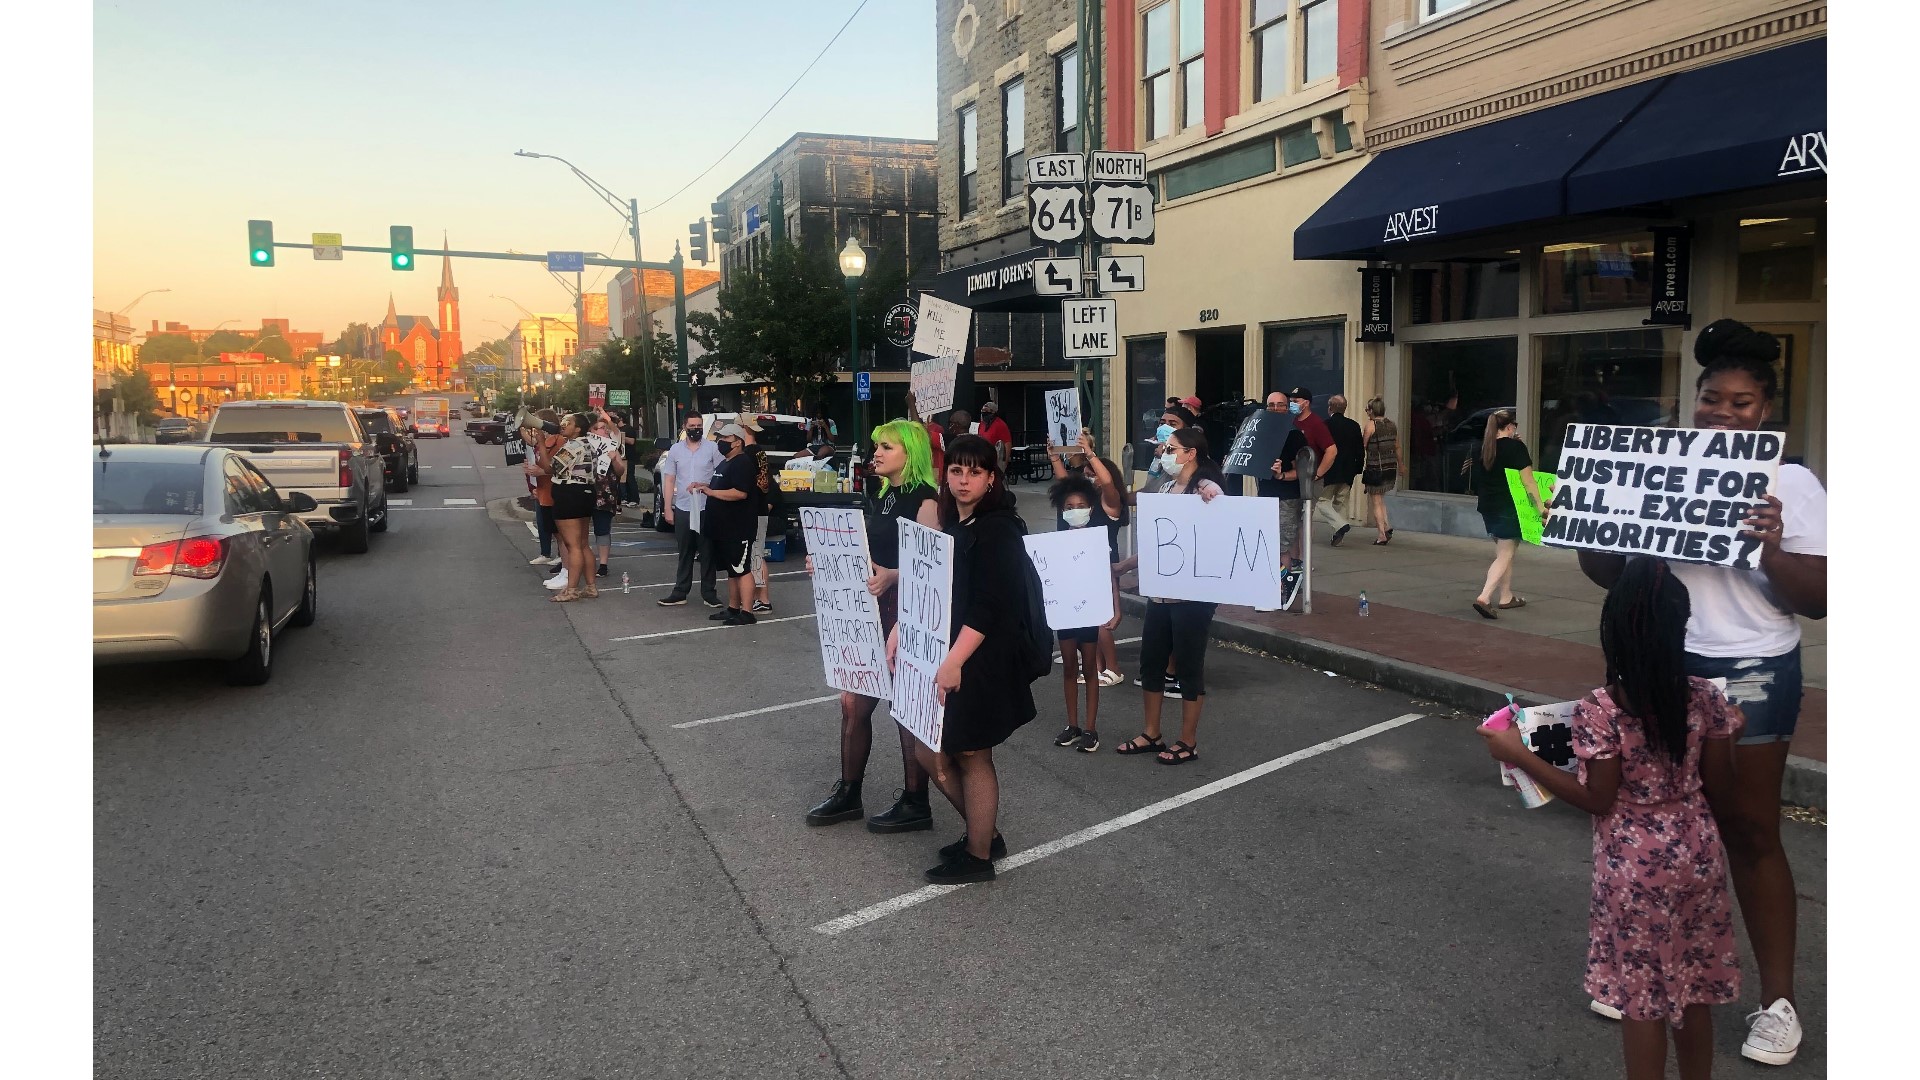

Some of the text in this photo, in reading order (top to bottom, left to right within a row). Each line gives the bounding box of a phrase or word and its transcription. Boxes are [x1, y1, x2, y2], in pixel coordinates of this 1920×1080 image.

[1036, 159, 1076, 177] EAST
[1096, 157, 1142, 175] NORTH
[1037, 198, 1077, 231] 64
[1383, 205, 1438, 241] ARVEST
[967, 261, 1033, 297] JIMMY JOHN'S
[1665, 237, 1676, 297] arvest.com
[1371, 275, 1380, 321] arvest.com
[1655, 301, 1685, 314] ARVEST
[927, 309, 943, 323] KILL
[1072, 306, 1106, 324] LEFT
[1200, 308, 1219, 323] 820
[1364, 323, 1389, 334] ARVEST
[934, 327, 945, 341] ME
[1072, 332, 1109, 349] LANE
[1239, 418, 1261, 433] LACK
[1230, 435, 1256, 451] LIVES
[1564, 425, 1780, 461] LIBERTY AND
[1221, 453, 1252, 467] MATTER
[1557, 456, 1687, 494] JUSTICE
[1695, 468, 1769, 499] FOR
[803, 510, 860, 547] POLICE
[901, 521, 909, 549] IF
[1541, 514, 1764, 569] MINORITIES?
[1155, 517, 1277, 585] BLM
[808, 552, 869, 583] THINK THEY
[912, 558, 932, 581] NOT
[814, 588, 870, 613] HAVE THE
[902, 577, 942, 632] LIVID
[821, 618, 881, 647] AUTHORITY
[825, 644, 878, 667] TO KILL A
[923, 631, 945, 667] NOT
[892, 657, 941, 746] LISTENING
